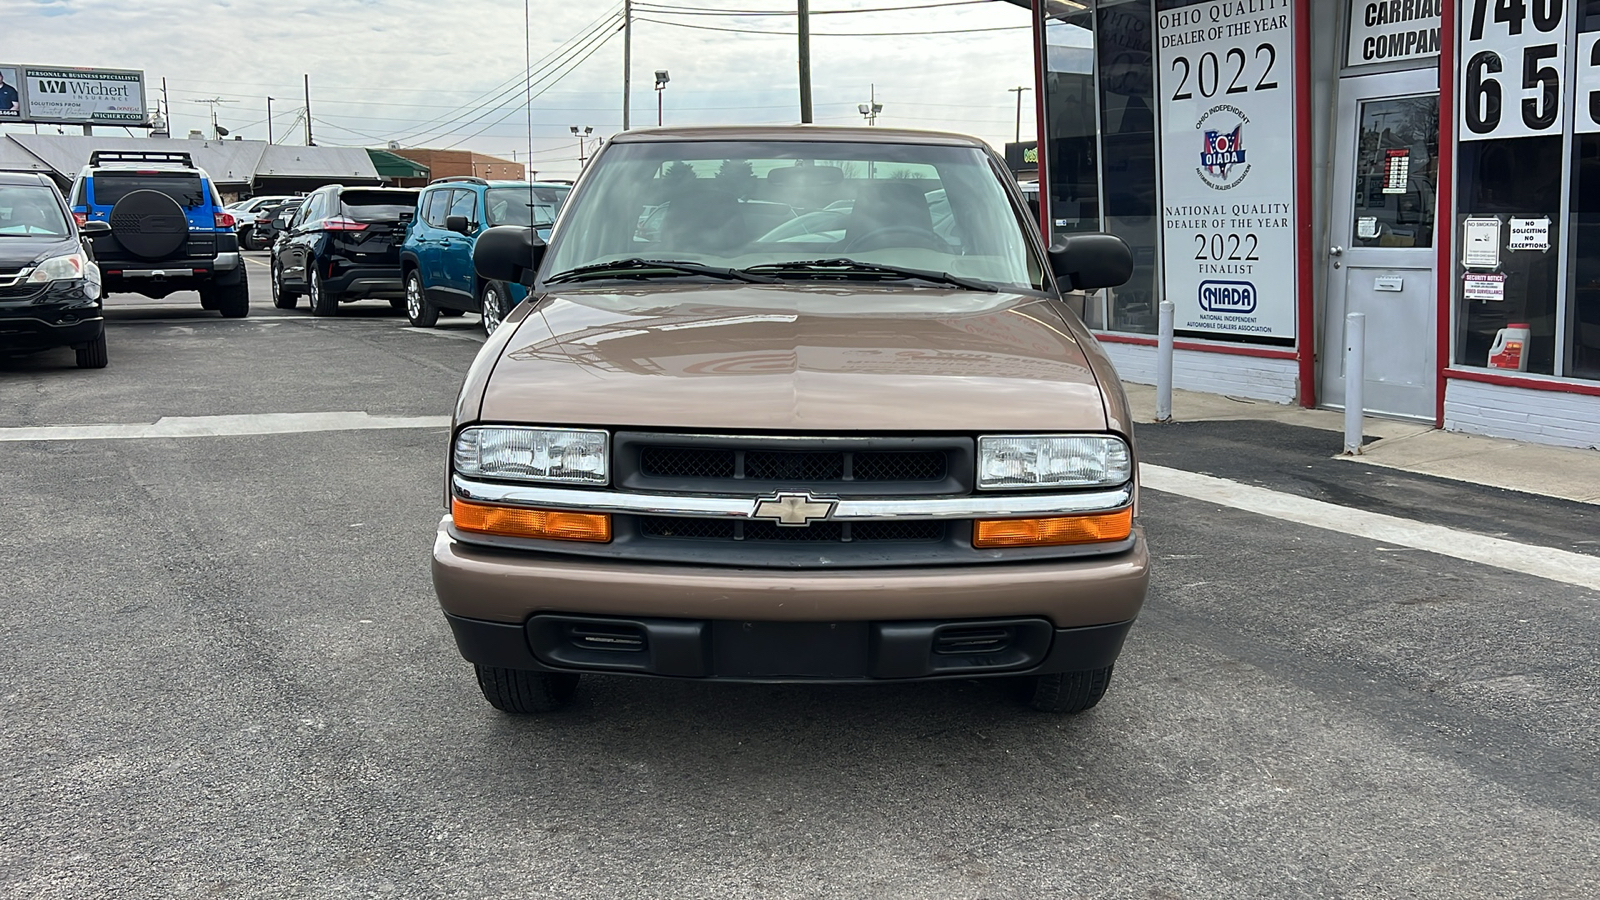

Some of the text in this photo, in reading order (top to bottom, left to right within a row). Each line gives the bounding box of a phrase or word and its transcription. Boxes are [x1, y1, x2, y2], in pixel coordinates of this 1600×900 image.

[1159, 8, 1201, 30] OHIO
[1161, 14, 1288, 49] DEALER OF THE YEAR
[1171, 43, 1278, 101] 2022
[69, 81, 129, 97] Wichert
[1195, 104, 1250, 130] OHIO INDEPENDENT
[1205, 151, 1238, 165] OIADA
[1195, 163, 1252, 191] AUTOMOBILE DEALERS ASSOCIATION
[1166, 203, 1290, 217] NATIONAL QUALITY
[1167, 217, 1289, 229] DEALER OF THE YEAR
[1194, 233, 1259, 261] 2022
[1198, 263, 1254, 275] FINALIST
[1203, 287, 1251, 306] NIADA
[1187, 321, 1272, 333] AUTOMOBILE DEALERS ASSOCIATION
[1224, 315, 1257, 324] INDEPENDENT
